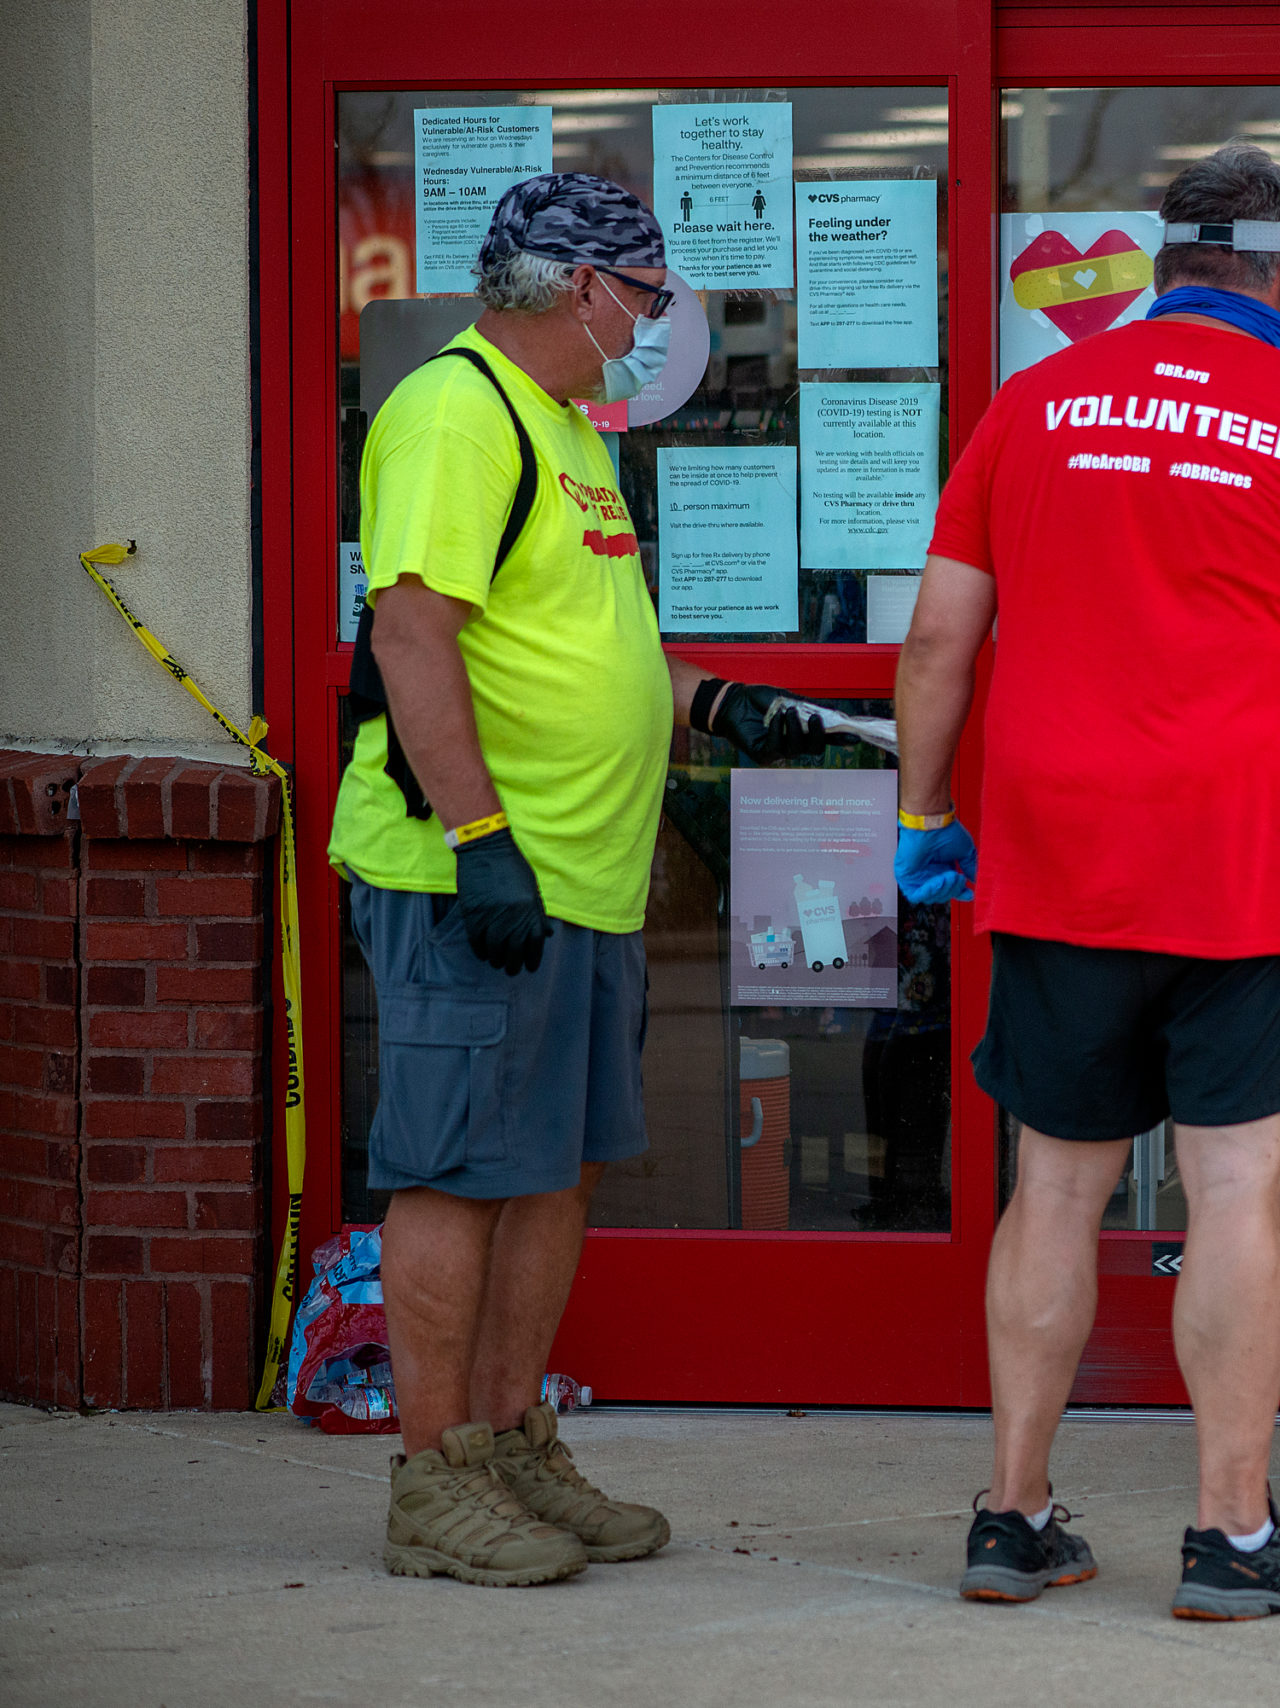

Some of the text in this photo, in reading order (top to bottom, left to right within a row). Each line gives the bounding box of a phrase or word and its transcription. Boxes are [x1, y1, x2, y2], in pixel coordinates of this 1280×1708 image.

[422, 116, 500, 125] Dedicated Hours for
[695, 116, 749, 127] Let's work
[422, 125, 539, 135] Vulnerable/At-Risk Customers
[680, 127, 764, 140] together to stay
[701, 139, 743, 151] healthy.
[684, 154, 709, 162] Centers
[722, 153, 748, 161] Disease
[750, 152, 774, 160] Control
[423, 165, 542, 176] Wednesday Vulnerable/At-Risk
[423, 177, 449, 186] Hours:
[423, 187, 486, 197] 9AM 10AM
[818, 193, 880, 204] CVS pharmacy
[673, 220, 775, 234] Please wait here.
[808, 217, 891, 230] Feeling under
[808, 230, 888, 242] the weather?
[1154, 362, 1210, 383] OBR.org
[821, 397, 918, 406] Coronavirus Disease 2019
[817, 408, 922, 418] (COVID-19) testing is NOT
[823, 419, 916, 429] currently available at this
[853, 430, 885, 439] location.
[668, 470, 680, 479] can
[690, 470, 709, 478] inside
[709, 472, 715, 480] at
[1068, 453, 1252, 489] #WeAreOBR #OBRCares
[683, 503, 710, 512] person
[711, 502, 750, 510] maximum
[813, 906, 835, 916] CVS
